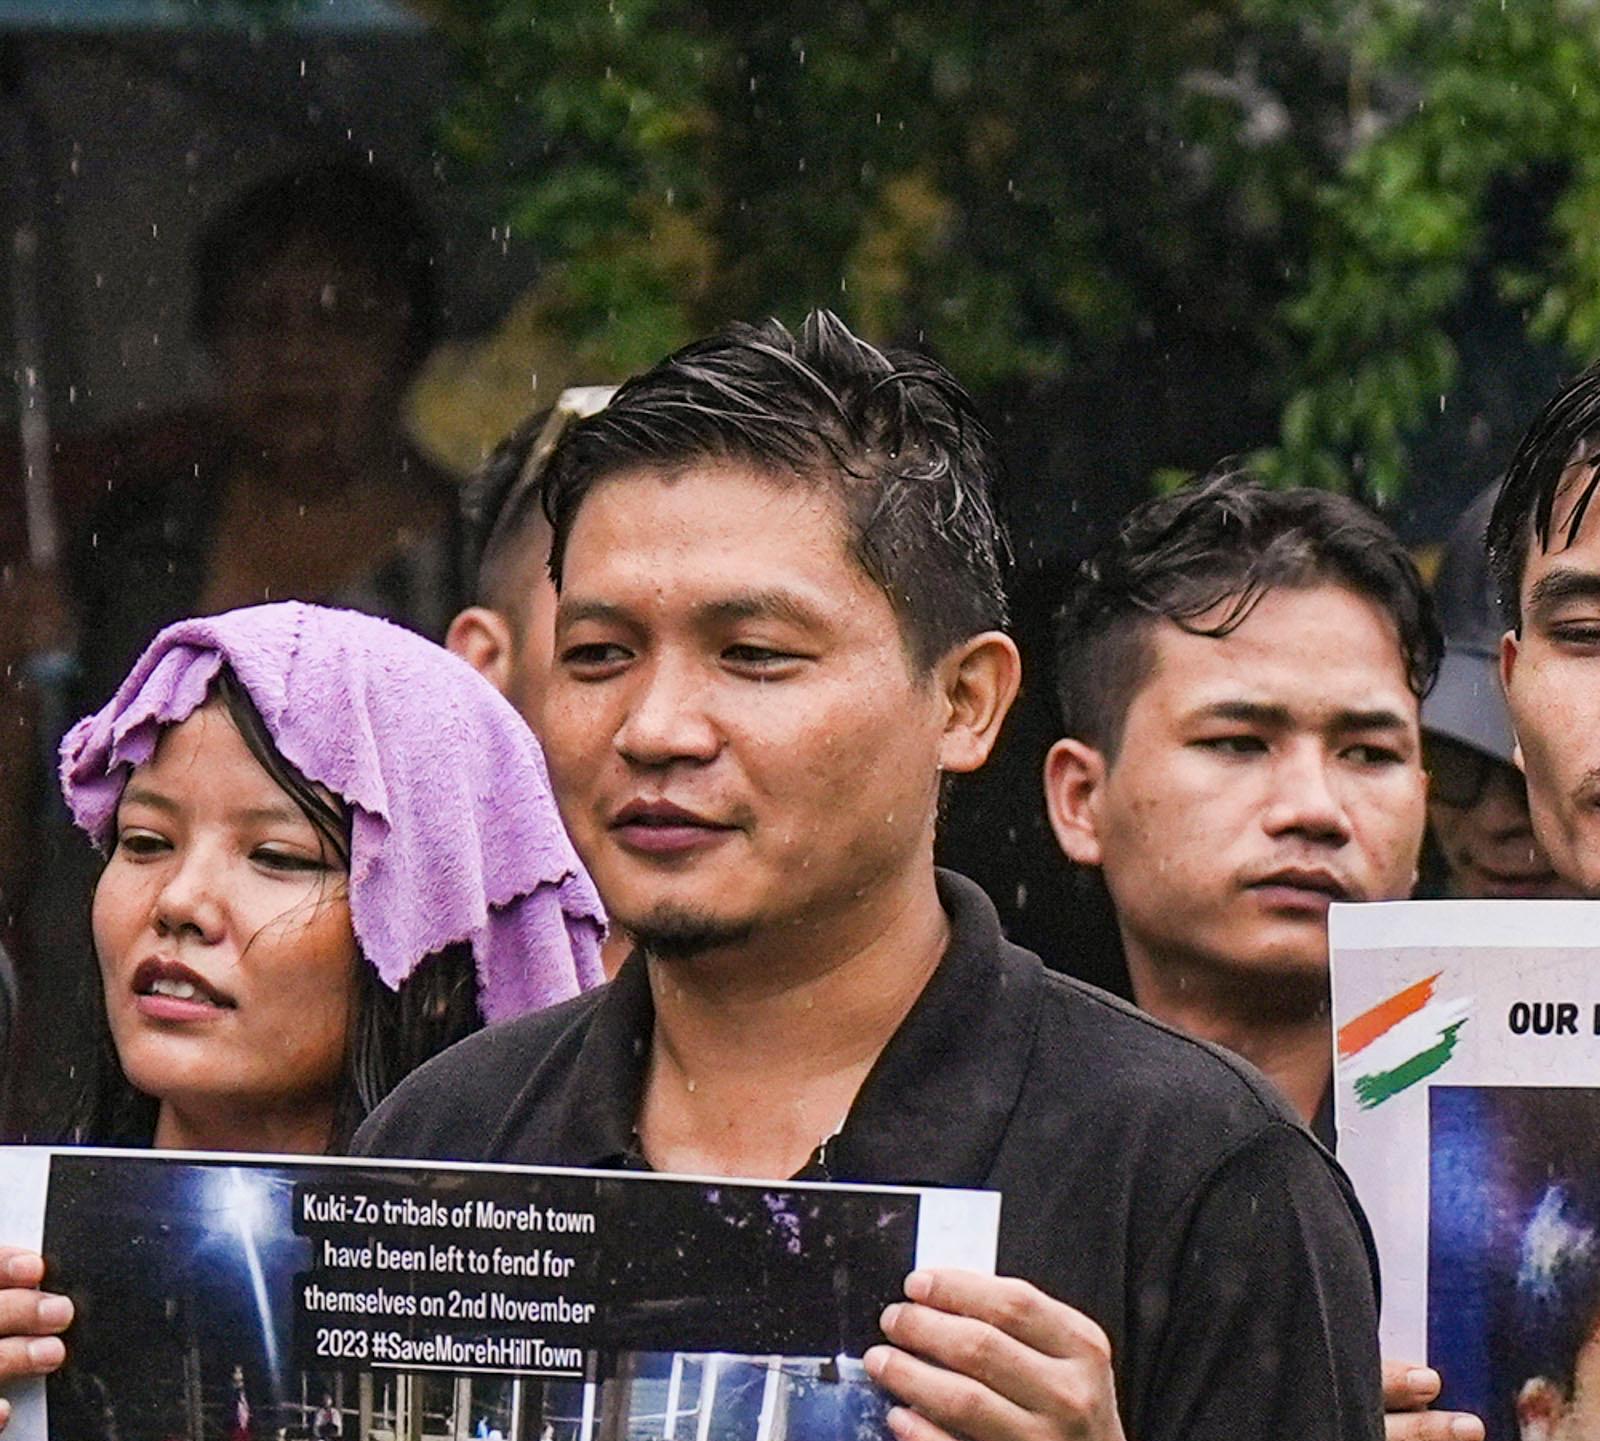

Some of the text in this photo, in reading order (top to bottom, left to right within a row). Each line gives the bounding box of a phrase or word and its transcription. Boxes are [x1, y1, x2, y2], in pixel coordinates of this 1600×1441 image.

[1509, 1002, 1579, 1036] OUR
[303, 1194, 595, 1233] Kuki-Zo tribals of Moreh town
[324, 1241, 574, 1277] have been left to fend for
[304, 1285, 595, 1324] themselves on 2nd November
[317, 1329, 582, 1368] 2023 #SaveMorehHillTown
